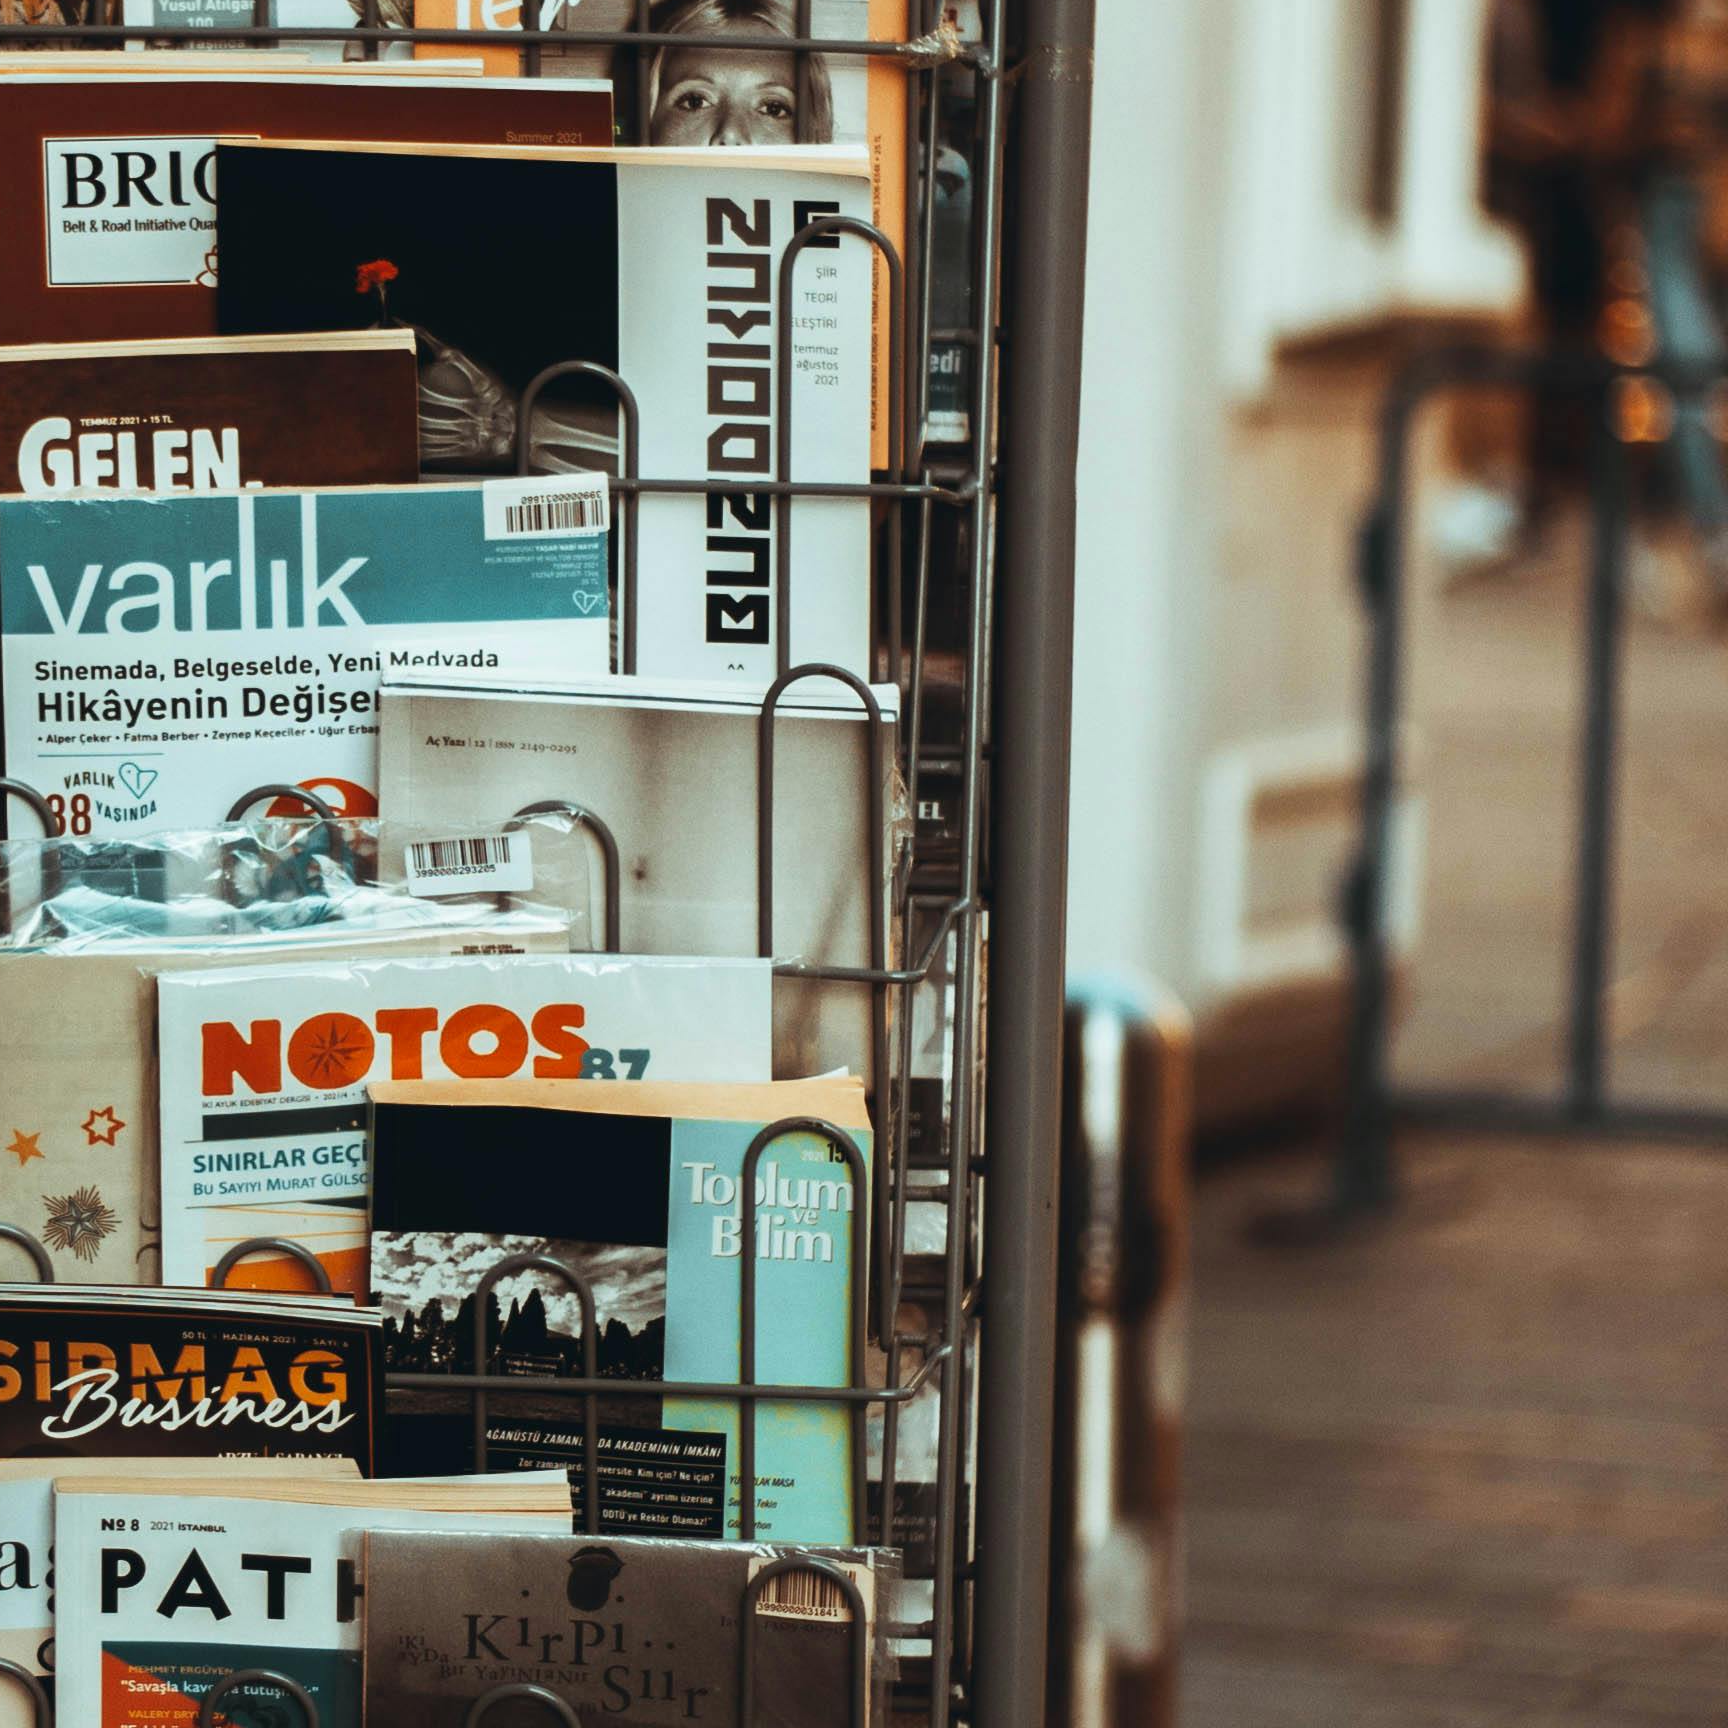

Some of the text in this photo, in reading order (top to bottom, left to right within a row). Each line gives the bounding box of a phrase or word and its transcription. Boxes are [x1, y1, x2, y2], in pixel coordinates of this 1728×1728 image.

[505, 130, 583, 145] Summer 2021
[63, 217, 187, 233] Belt Road Initiative
[794, 343, 839, 355] temmuz
[796, 358, 839, 372] ağustos
[814, 374, 839, 386] 2021
[80, 415, 141, 428] TEMMUZ 2021
[705, 197, 772, 645] BUZDOKUZ
[27, 493, 371, 636] varlık
[35, 652, 380, 683] Sinemada, Belgeselde, Yeni
[37, 689, 229, 729] Hikâyenin
[46, 729, 252, 745] Alper Çeker Fatma Berber Zeynep
[64, 771, 115, 791] VARLIK
[202, 1003, 591, 1097] NOTOS
[192, 1142, 307, 1174] SINIRLAR
[681, 1161, 854, 1219] Toplum
[711, 1213, 834, 1263] Blim
[40, 1367, 356, 1439] Business
[150, 1520, 175, 1531] 2021
[129, 1709, 171, 1720] VALERY
